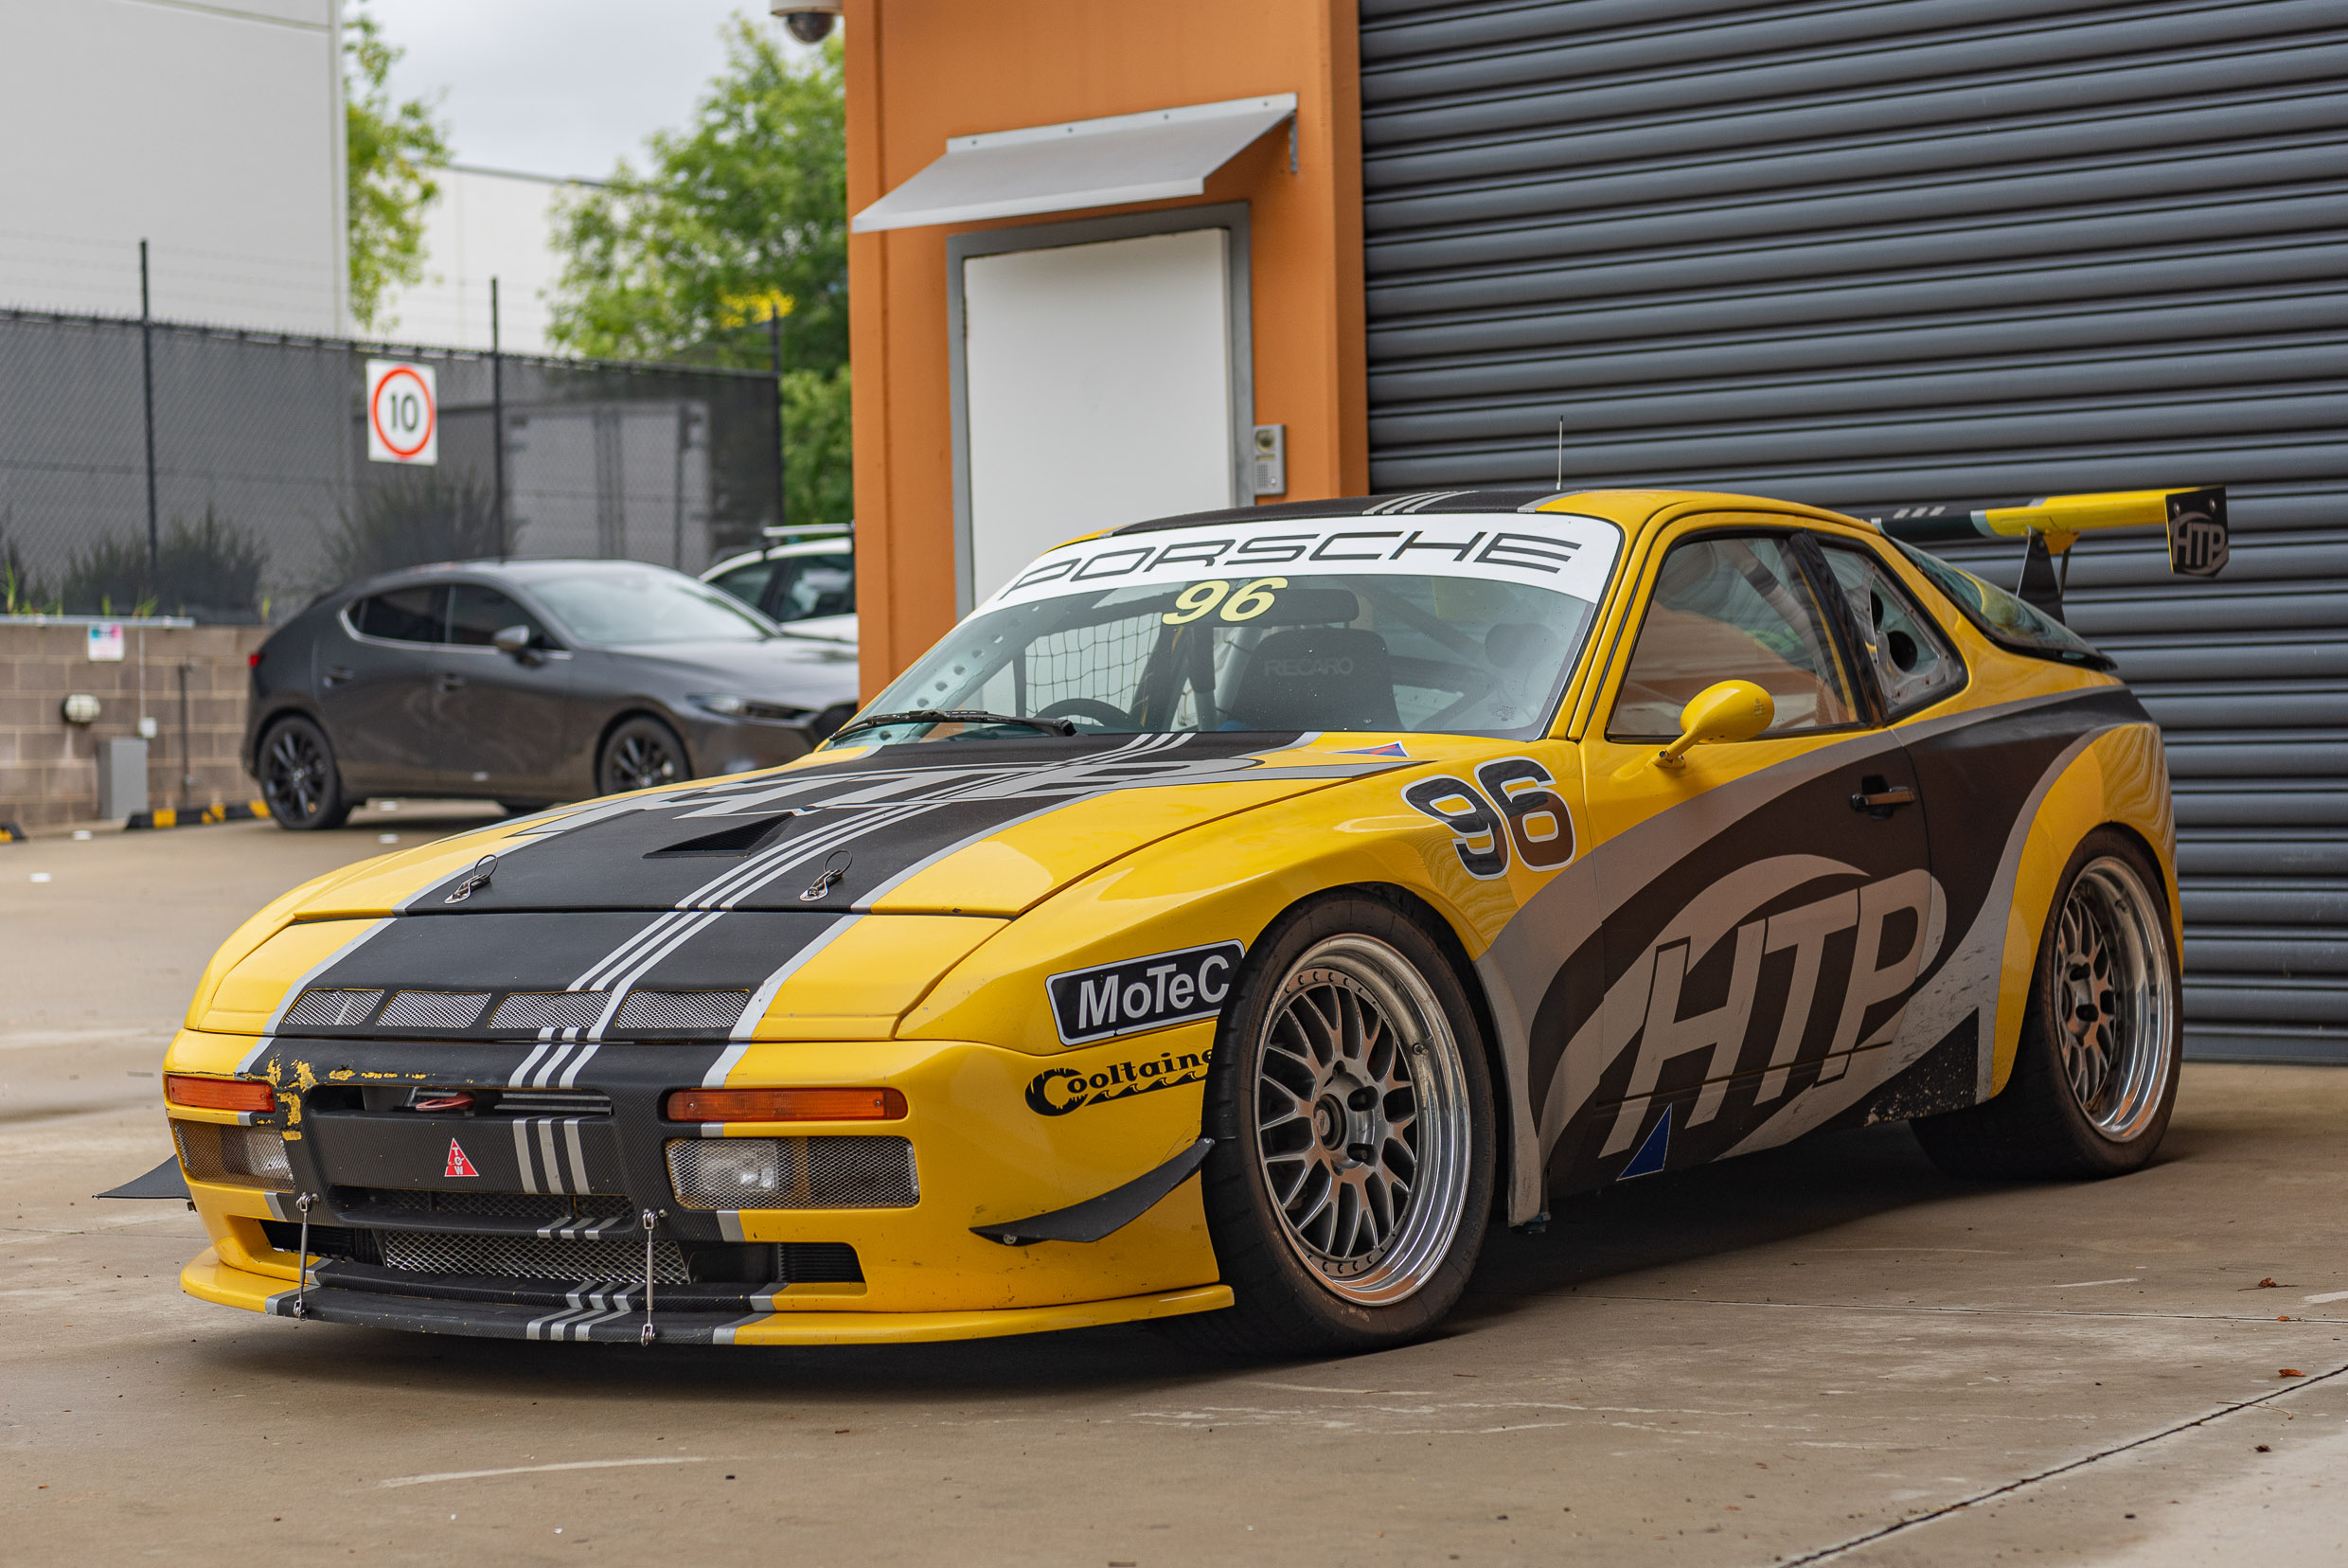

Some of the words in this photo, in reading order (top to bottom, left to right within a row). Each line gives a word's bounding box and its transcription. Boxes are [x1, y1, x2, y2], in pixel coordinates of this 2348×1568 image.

[391, 394, 418, 432] 10
[999, 531, 1582, 599] PORSCHE
[2172, 522, 2226, 567] HTP
[1162, 577, 1289, 624] 96
[1265, 657, 1354, 676] RECARO
[1400, 756, 1576, 881] 96
[1078, 955, 1229, 1029] MoTeC
[1598, 868, 1947, 1159] HTP
[453, 1147, 464, 1175] TOW
